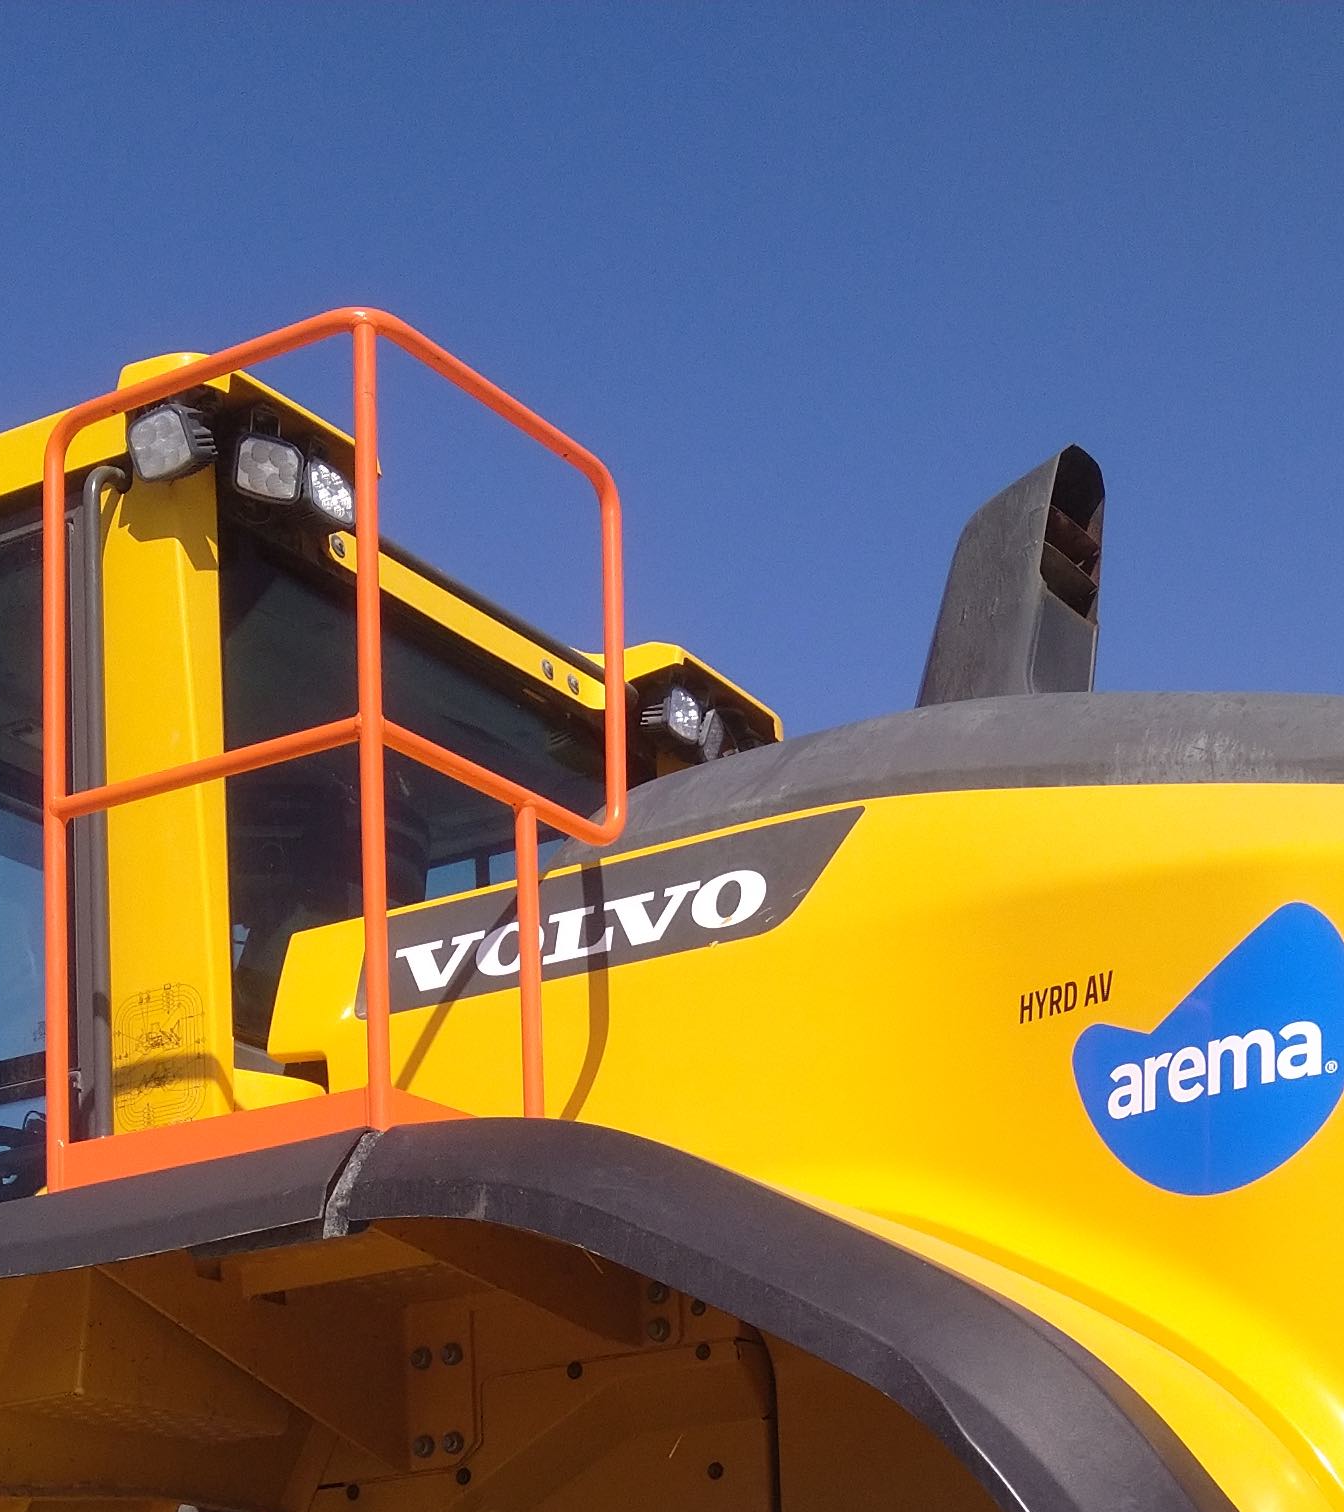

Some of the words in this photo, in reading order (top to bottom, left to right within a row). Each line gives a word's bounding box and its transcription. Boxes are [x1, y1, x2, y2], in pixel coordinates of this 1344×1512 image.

[395, 869, 767, 992] VOLVO
[1019, 981, 1077, 1025] HYRD
[1083, 969, 1113, 1008] AV
[1107, 1020, 1322, 1120] arema
